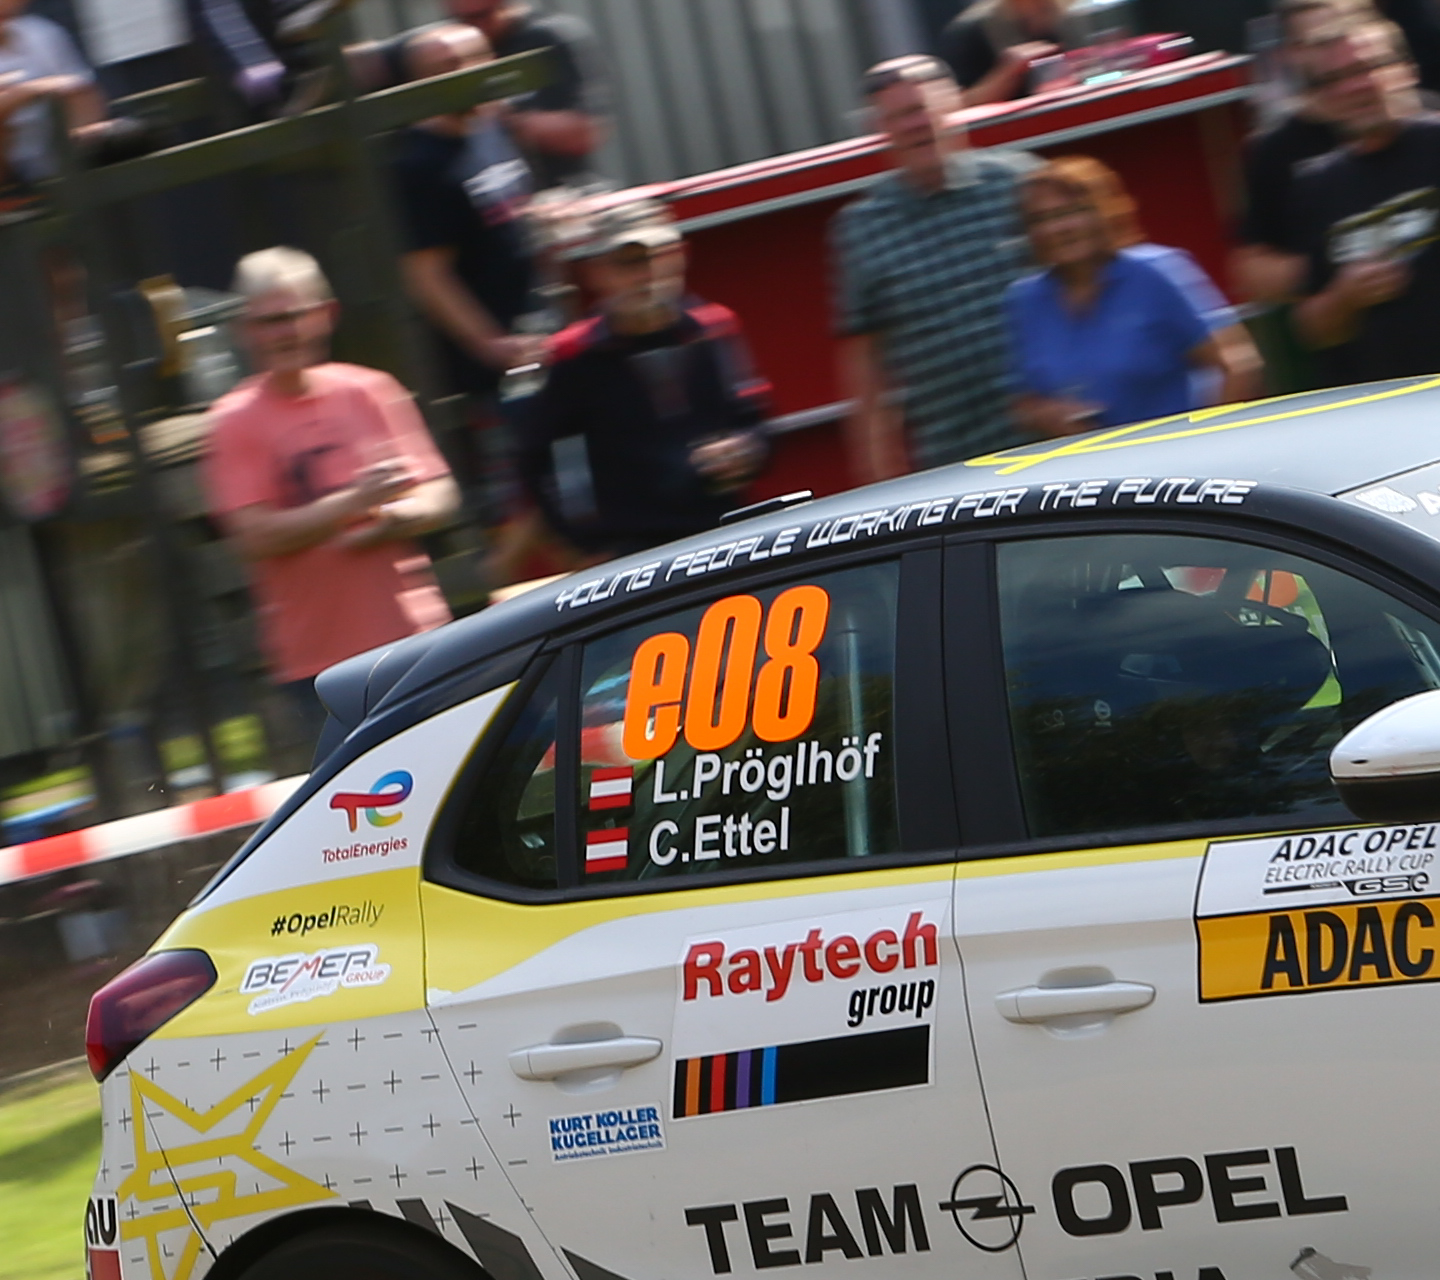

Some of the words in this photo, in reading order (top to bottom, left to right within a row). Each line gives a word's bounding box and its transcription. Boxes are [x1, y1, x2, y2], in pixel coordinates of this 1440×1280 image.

[554, 562, 661, 612] YOUNG
[665, 526, 803, 582] PEOPLE
[806, 497, 955, 549] WORKING
[951, 487, 1028, 520] FOR
[1039, 480, 1109, 511] THE
[1112, 478, 1258, 506] FUTURE
[622, 584, 830, 760] e08
[652, 732, 883, 804] L.Pröglhöf
[321, 835, 408, 865] TotalEnergies
[648, 806, 790, 867] C.Ettel
[1268, 832, 1360, 864] ADAC
[1364, 825, 1437, 854] OPEL
[1264, 860, 1344, 885] ELECTRIC
[1342, 854, 1395, 876] RALLY
[1398, 853, 1435, 871] CUP
[270, 899, 385, 938] #OpelRally
[682, 910, 938, 1003] Raytech
[1260, 900, 1436, 991] ADAC
[243, 949, 372, 994] BEMER
[345, 968, 385, 984] GROUP
[847, 978, 935, 1027] group
[549, 1114, 592, 1135] KURT
[595, 1106, 660, 1128] KOLLER
[551, 1123, 661, 1151] KUGELLAGER
[685, 1182, 931, 1276] TEAM
[1050, 1146, 1349, 1238] OPEL
